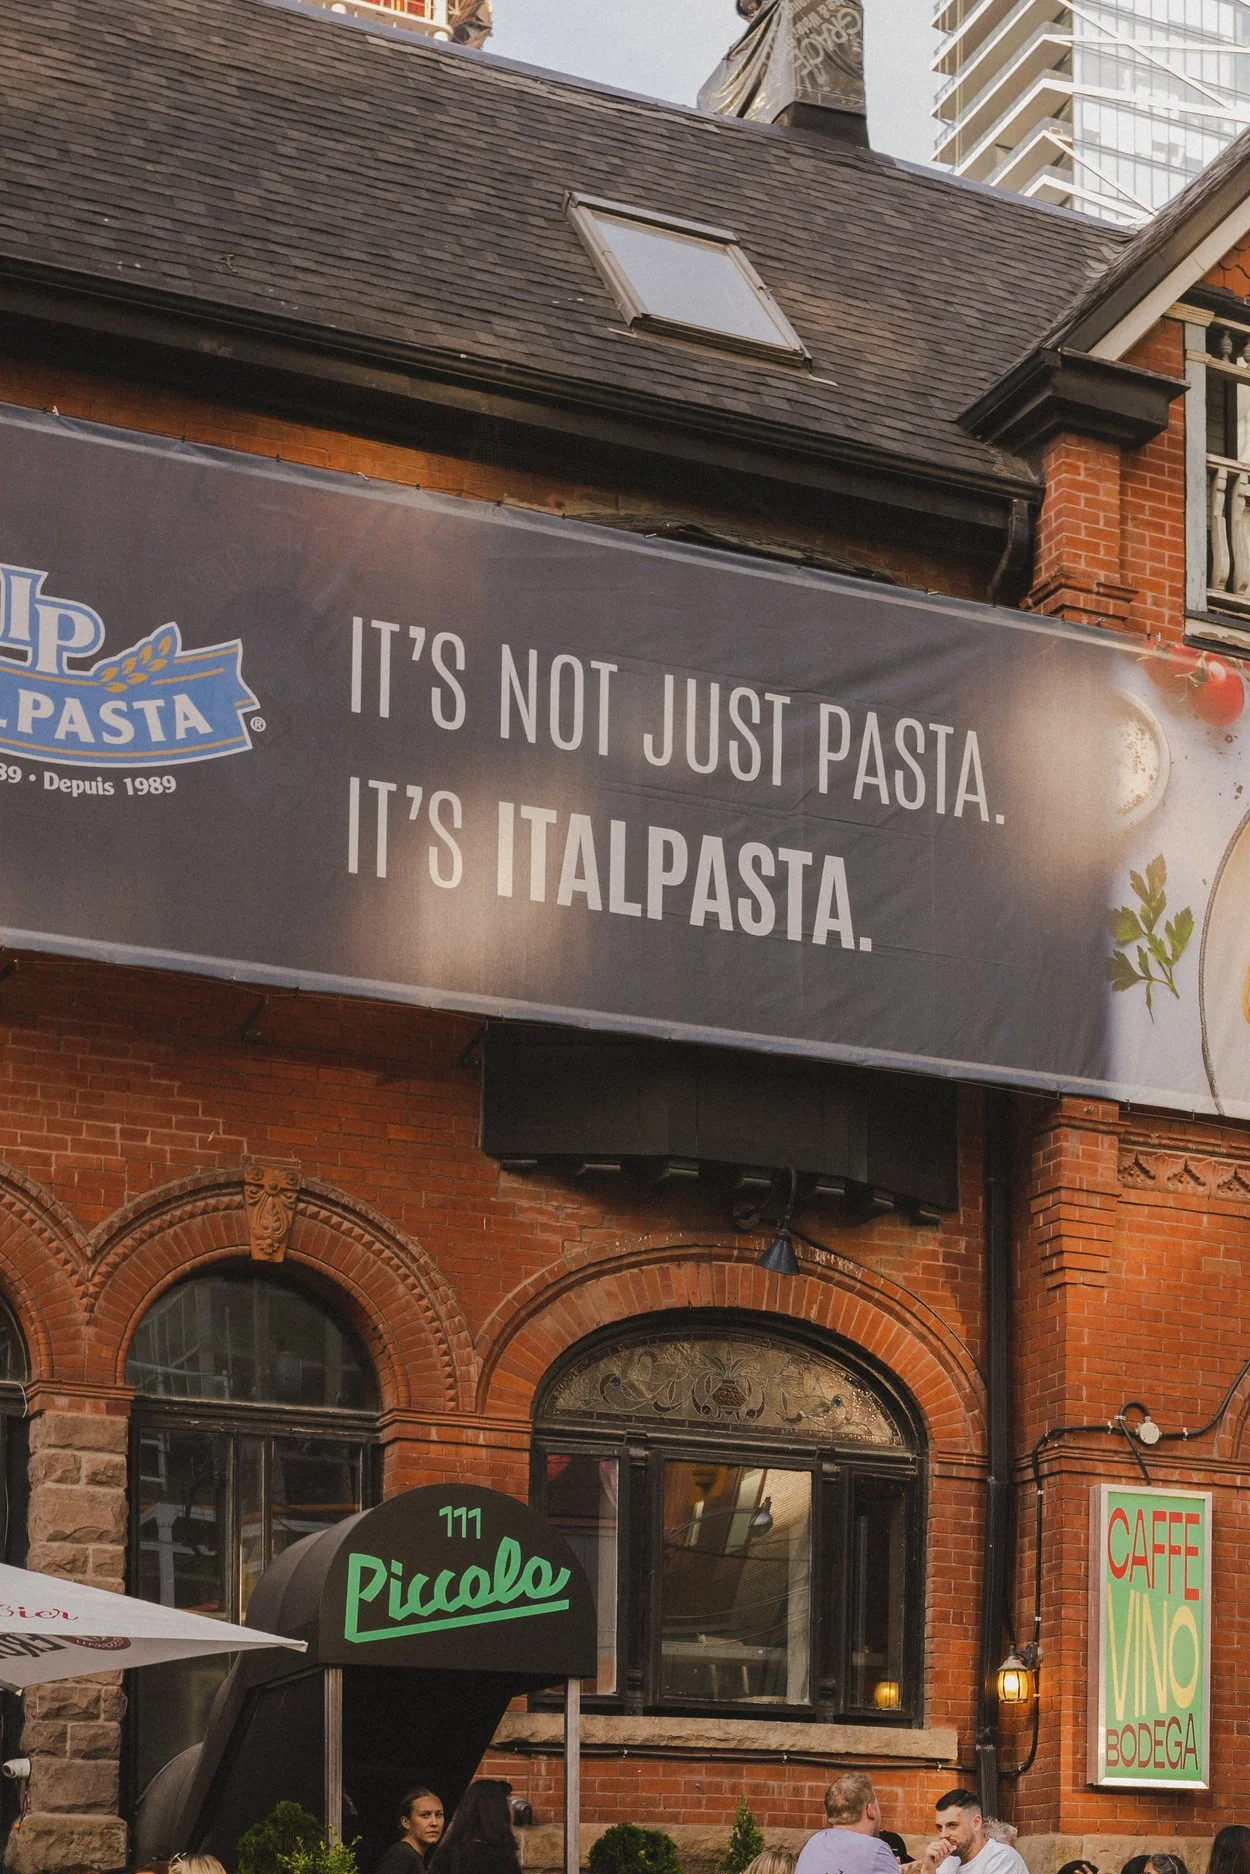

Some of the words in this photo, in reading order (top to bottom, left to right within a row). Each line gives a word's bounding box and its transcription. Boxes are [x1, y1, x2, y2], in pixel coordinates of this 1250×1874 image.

[0, 688, 214, 745] PASTA
[500, 643, 618, 756] NOT
[643, 673, 792, 787] JUST
[819, 703, 1006, 825] PASTA.
[43, 770, 116, 798] Depuis
[123, 774, 178, 796] 1989
[497, 801, 873, 953] ITALPASTA.
[438, 1505, 483, 1540] 111
[1107, 1506, 1201, 1601] CAFFE
[344, 1536, 572, 1644] Piccolo
[1107, 1582, 1199, 1721] VINO
[1106, 1713, 1199, 1771] BODEGA
